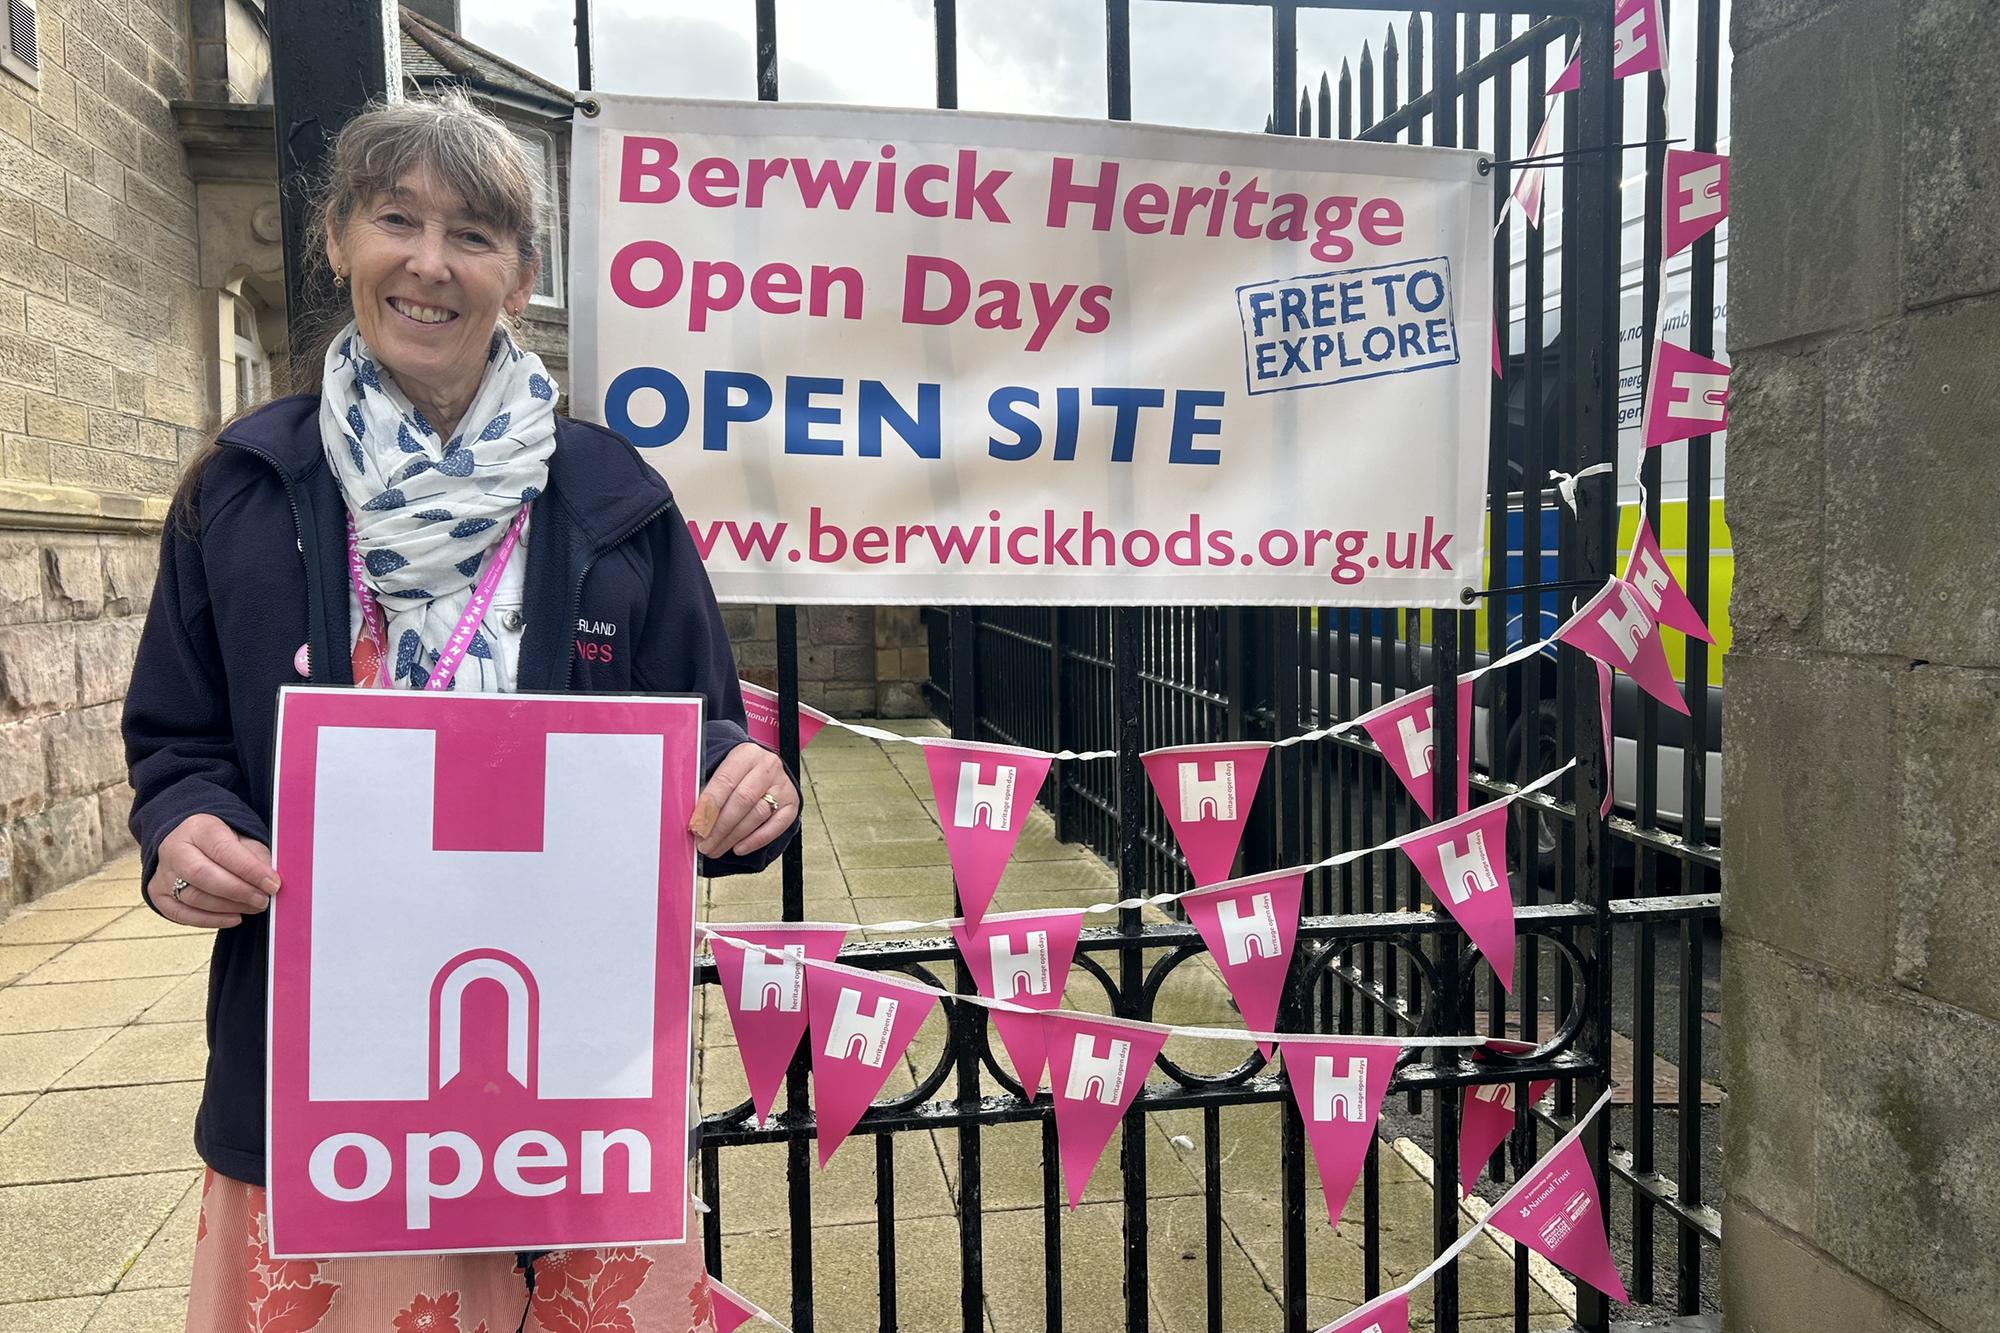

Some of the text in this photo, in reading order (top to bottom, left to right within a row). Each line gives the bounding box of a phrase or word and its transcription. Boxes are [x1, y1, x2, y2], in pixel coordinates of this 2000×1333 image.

[618, 135, 1404, 263] Berwick Heritage
[610, 240, 1113, 352] Open Days
[1249, 269, 1446, 338] FREE TO
[1256, 317, 1452, 381] EXPLORE
[604, 366, 1226, 465] OPEN SITE
[577, 618, 616, 637] RLAND
[1004, 784, 1012, 801] open
[1000, 801, 1010, 829] heritage
[1265, 910, 1274, 927] open
[1270, 927, 1279, 955] heritage
[791, 980, 800, 1010] heritage
[872, 1036, 886, 1065] heritage
[882, 1018, 891, 1036] open
[1110, 1076, 1121, 1104] heritage
[1117, 1059, 1125, 1076] open
[1356, 1093, 1364, 1120] heritage
[308, 1129, 653, 1230] open
[1528, 1183, 1556, 1210] National
[1553, 1170, 1571, 1186] Trust
